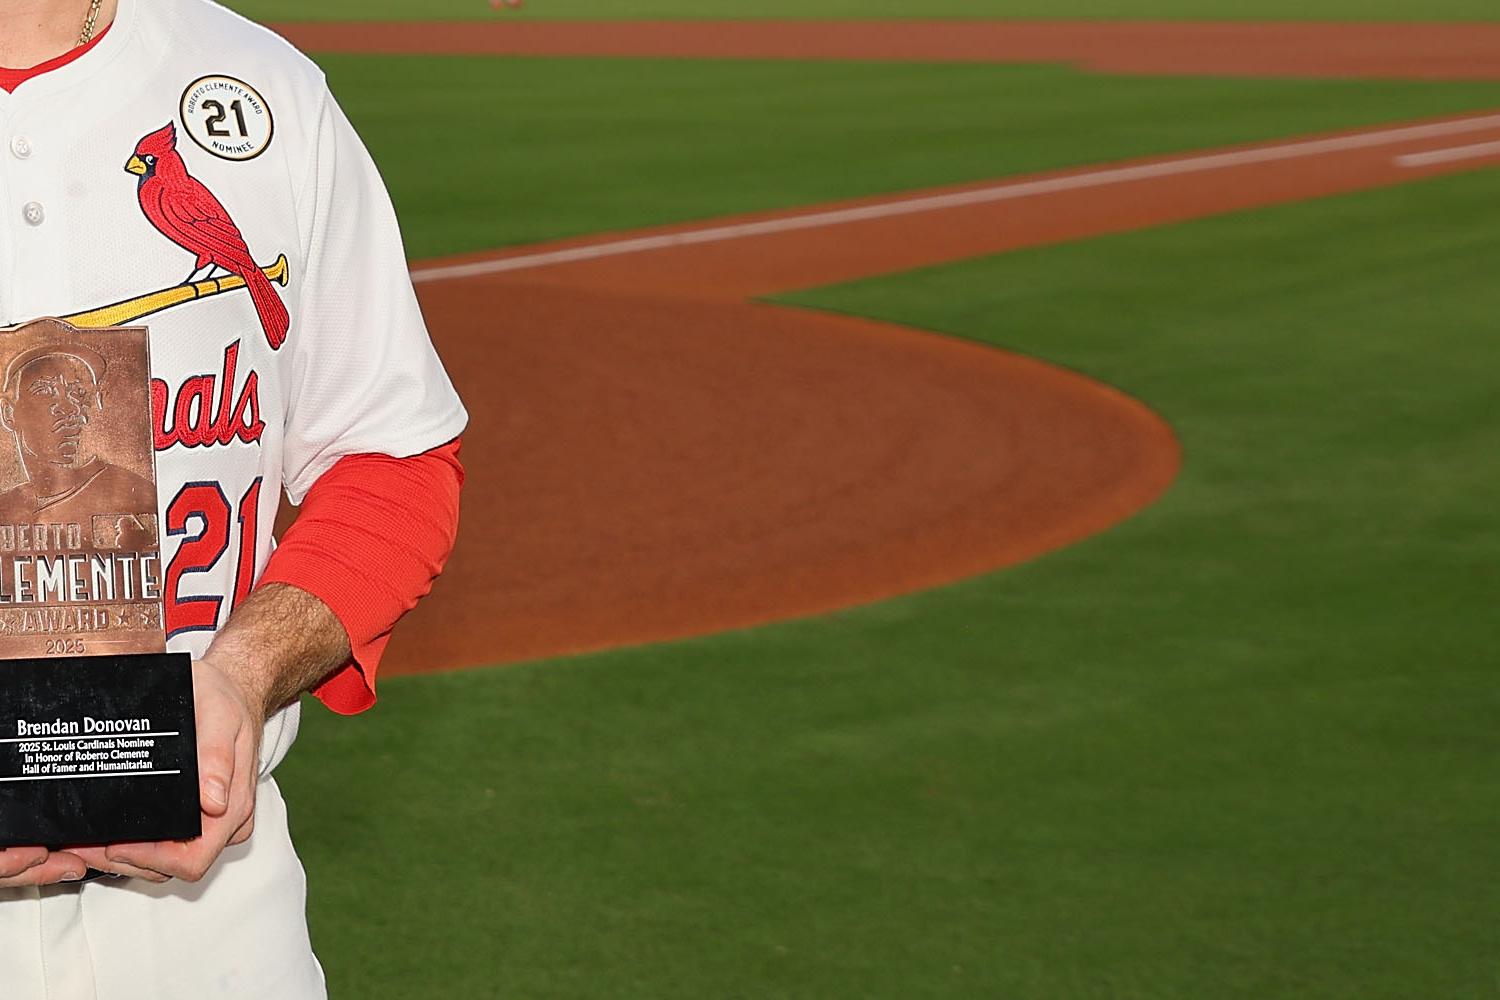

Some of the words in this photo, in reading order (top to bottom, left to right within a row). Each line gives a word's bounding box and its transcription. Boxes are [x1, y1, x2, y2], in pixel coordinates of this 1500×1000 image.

[188, 87, 206, 114] ROBERTO
[205, 82, 242, 96] CLEMENTE
[243, 93, 263, 115] AWARD
[201, 99, 248, 137] 21
[212, 140, 255, 154] NOMINEE
[164, 476, 263, 642] 21
[23, 608, 110, 632] AWARD
[45, 637, 86, 655] 2025
[17, 718, 79, 736] Brendan
[83, 716, 151, 733] Donovan
[18, 742, 41, 753] 2025
[41, 741, 52, 752] St.
[53, 740, 76, 751] Louis
[77, 739, 115, 750] Cardinals
[116, 738, 155, 749] Nominee
[24, 753, 34, 763] In
[35, 752, 62, 763] Honor
[64, 751, 74, 762] of
[75, 750, 109, 761] Roberto
[110, 749, 150, 760] Clemente
[22, 764, 40, 775] Hall
[41, 763, 51, 774] of
[51, 762, 78, 773] Famer
[79, 761, 95, 772] and
[96, 760, 153, 771] Humanitarian
